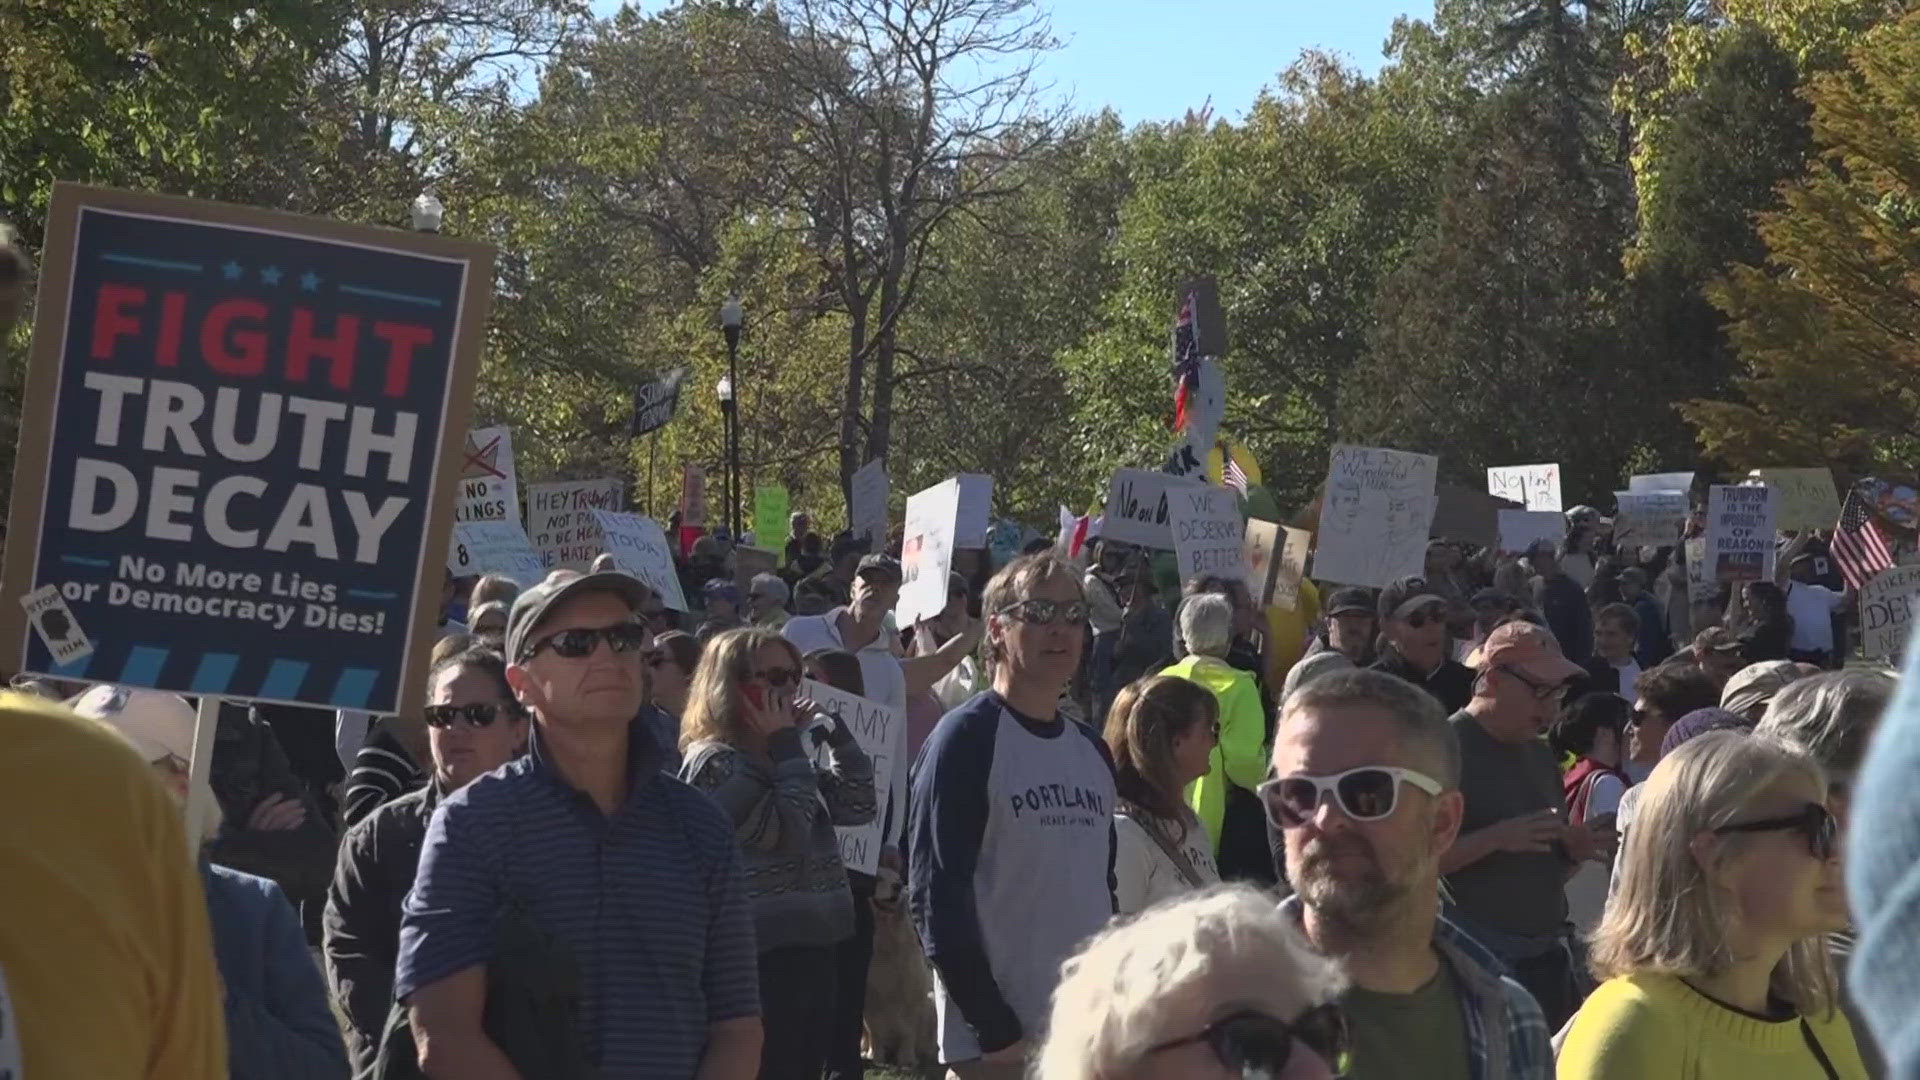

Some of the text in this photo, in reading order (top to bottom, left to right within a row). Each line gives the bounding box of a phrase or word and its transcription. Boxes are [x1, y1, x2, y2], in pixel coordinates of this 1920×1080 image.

[90, 283, 435, 398] FIGHT
[84, 371, 419, 484] TRUTH
[466, 481, 488, 499] NO
[1493, 471, 1520, 489] No
[536, 489, 570, 512] HEY
[1116, 480, 1138, 519] No
[1188, 492, 1216, 514] WE
[1742, 503, 1762, 513] THE
[68, 458, 410, 565] DECAY
[546, 514, 572, 530] NOT
[536, 533, 549, 547] TO
[577, 526, 603, 542] HER
[1179, 519, 1236, 542] DESERVE
[1732, 528, 1754, 538] OF
[560, 546, 591, 562] HATE
[1717, 539, 1765, 551] REASON
[119, 554, 338, 602] No More Lies
[1877, 571, 1907, 593] LIKE
[62, 581, 386, 635] or Democracy Dies!
[855, 702, 891, 744] MY
